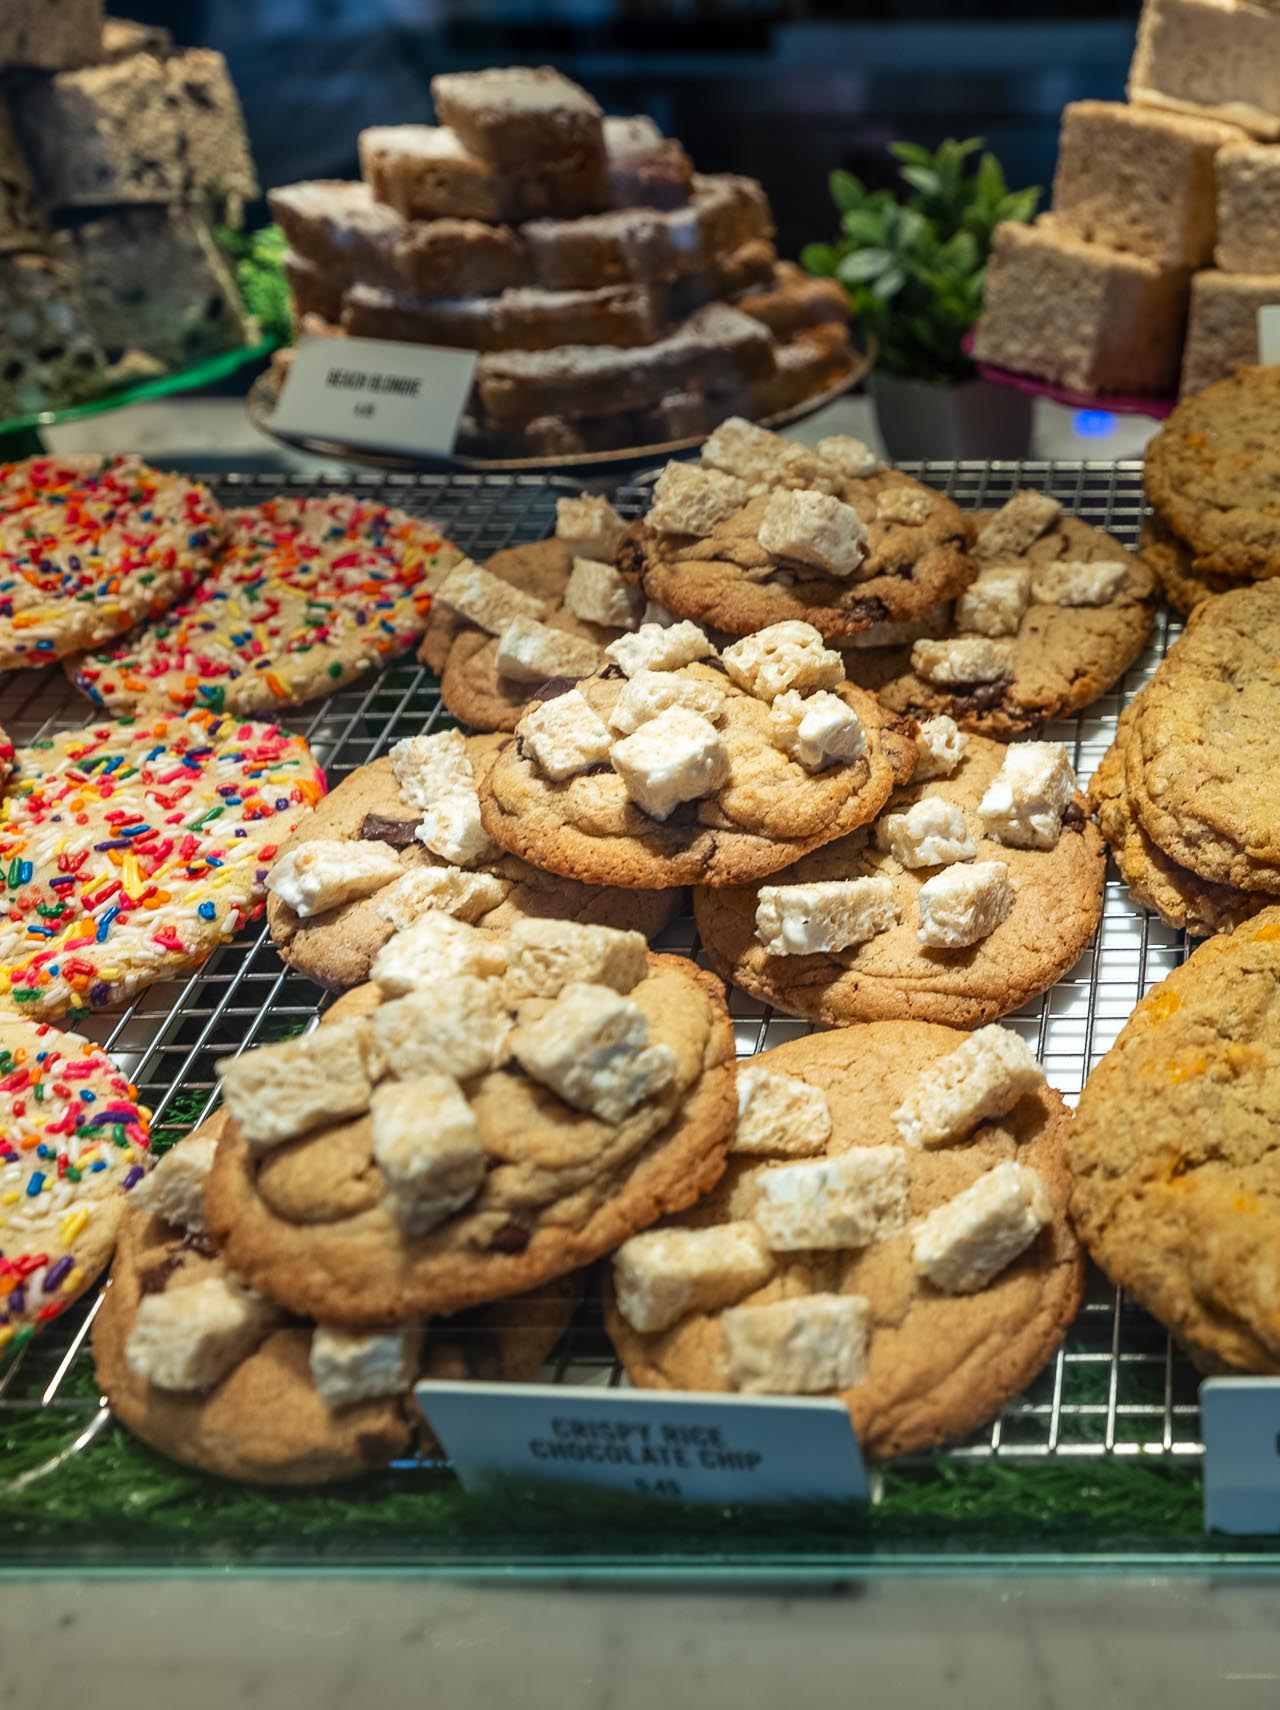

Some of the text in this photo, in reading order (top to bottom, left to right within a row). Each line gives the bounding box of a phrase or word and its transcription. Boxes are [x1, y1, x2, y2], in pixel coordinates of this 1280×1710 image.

[551, 1416, 723, 1447] CRISPY RICE
[528, 1438, 762, 1471] CHOCOLATE CHIP
